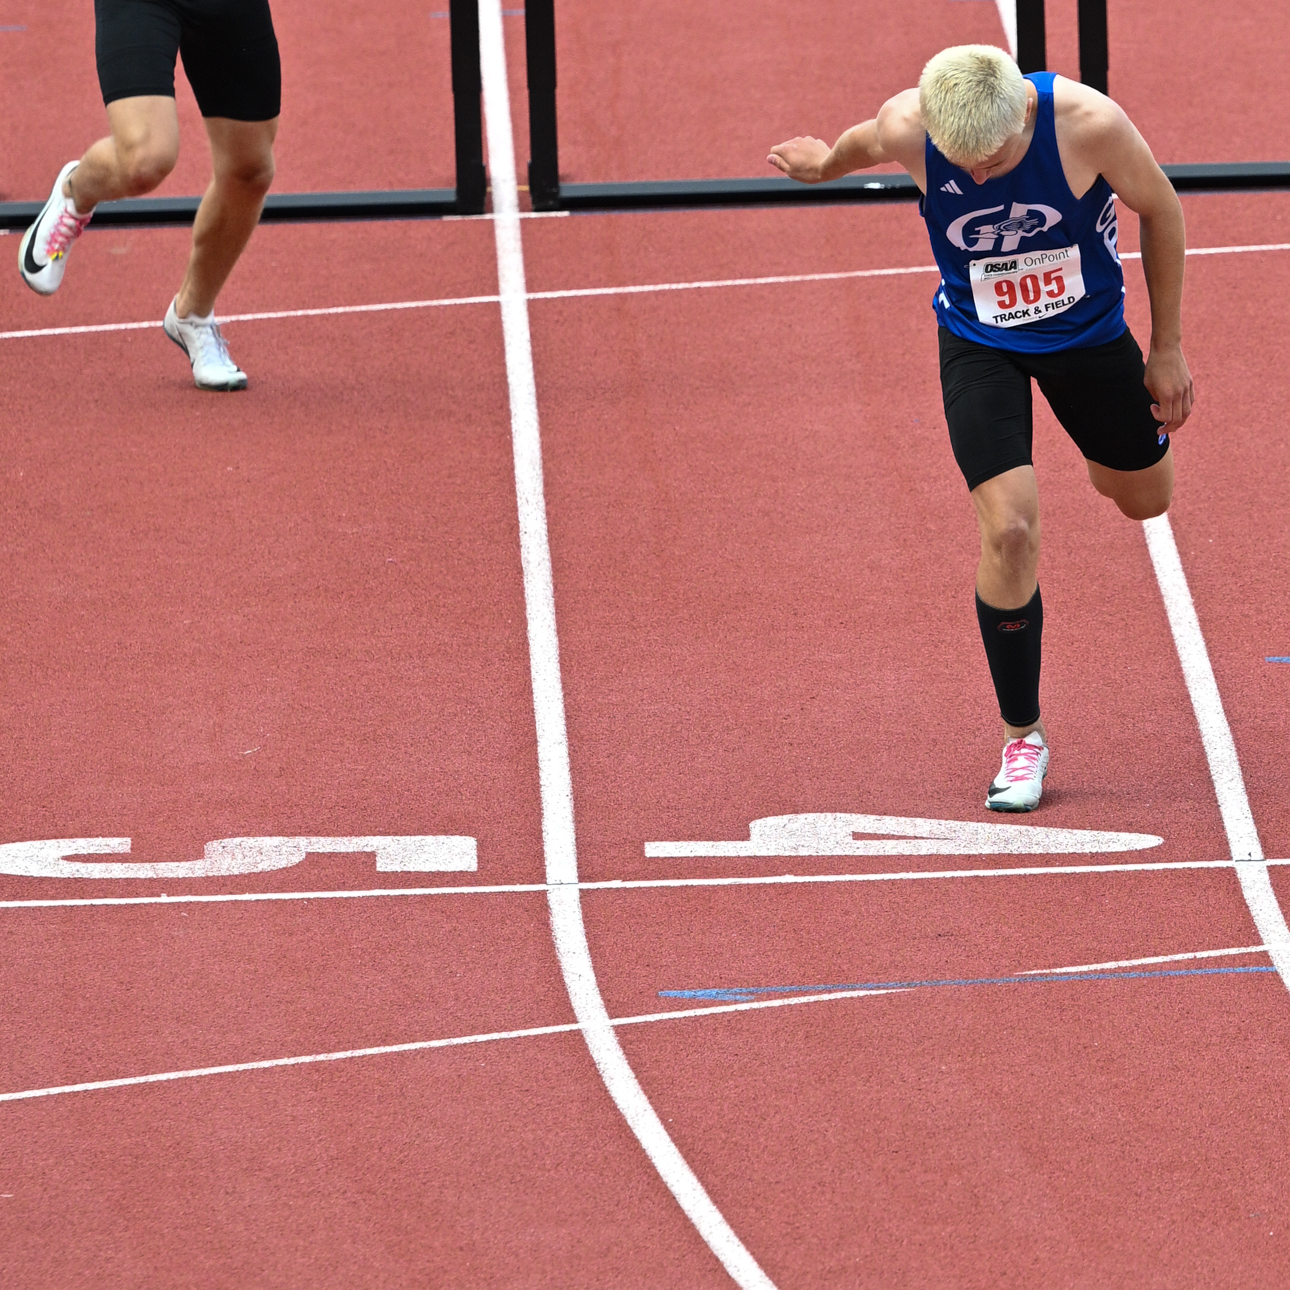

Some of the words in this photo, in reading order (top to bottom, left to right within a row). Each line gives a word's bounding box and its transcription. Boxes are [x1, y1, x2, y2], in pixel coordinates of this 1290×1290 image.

[984, 259, 1018, 274] OSAA
[1023, 249, 1070, 267] OnPoint
[992, 308, 1031, 324] TRACK
[1033, 305, 1042, 315] &
[1044, 295, 1076, 312] FIELD
[994, 267, 1066, 310] 905
[644, 812, 1164, 857] 4
[0, 835, 478, 879] 5
